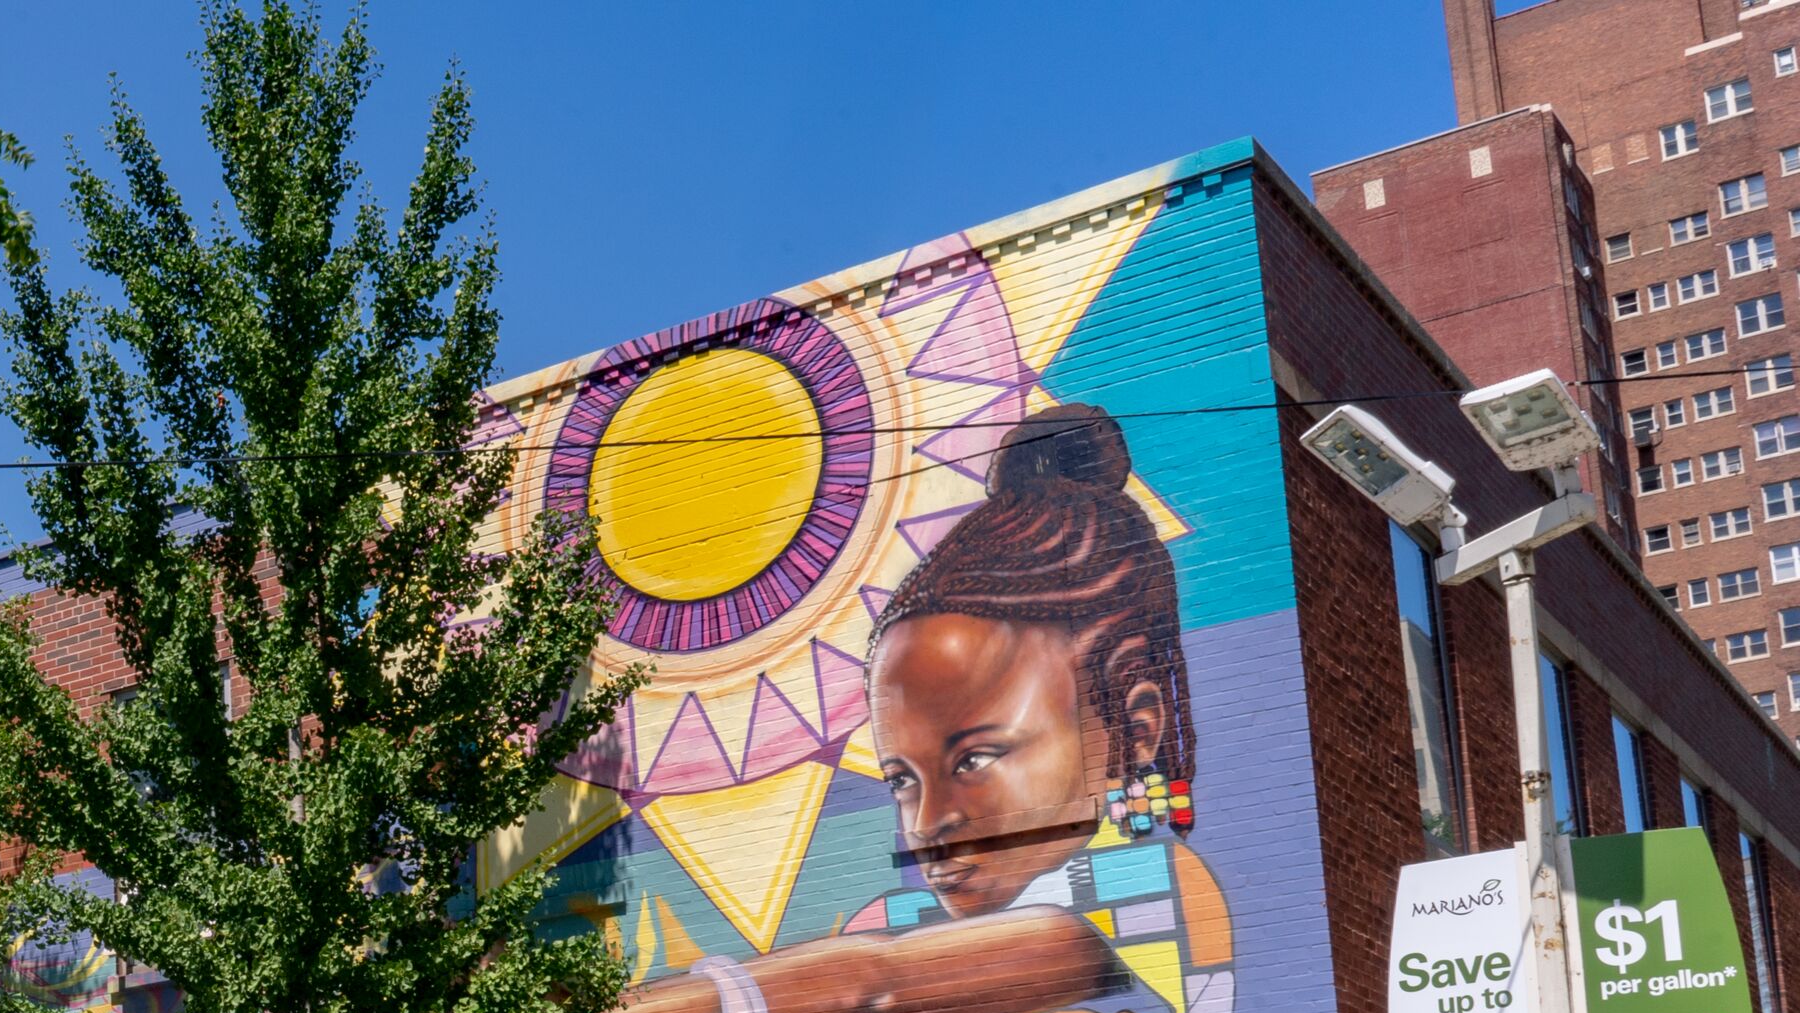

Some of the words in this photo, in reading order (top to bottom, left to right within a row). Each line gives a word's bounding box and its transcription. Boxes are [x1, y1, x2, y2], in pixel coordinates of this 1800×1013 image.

[1594, 900, 1684, 973] $1
[1399, 952, 1512, 993] Save
[1600, 975, 1643, 1000] per
[1482, 986, 1513, 1012] to
